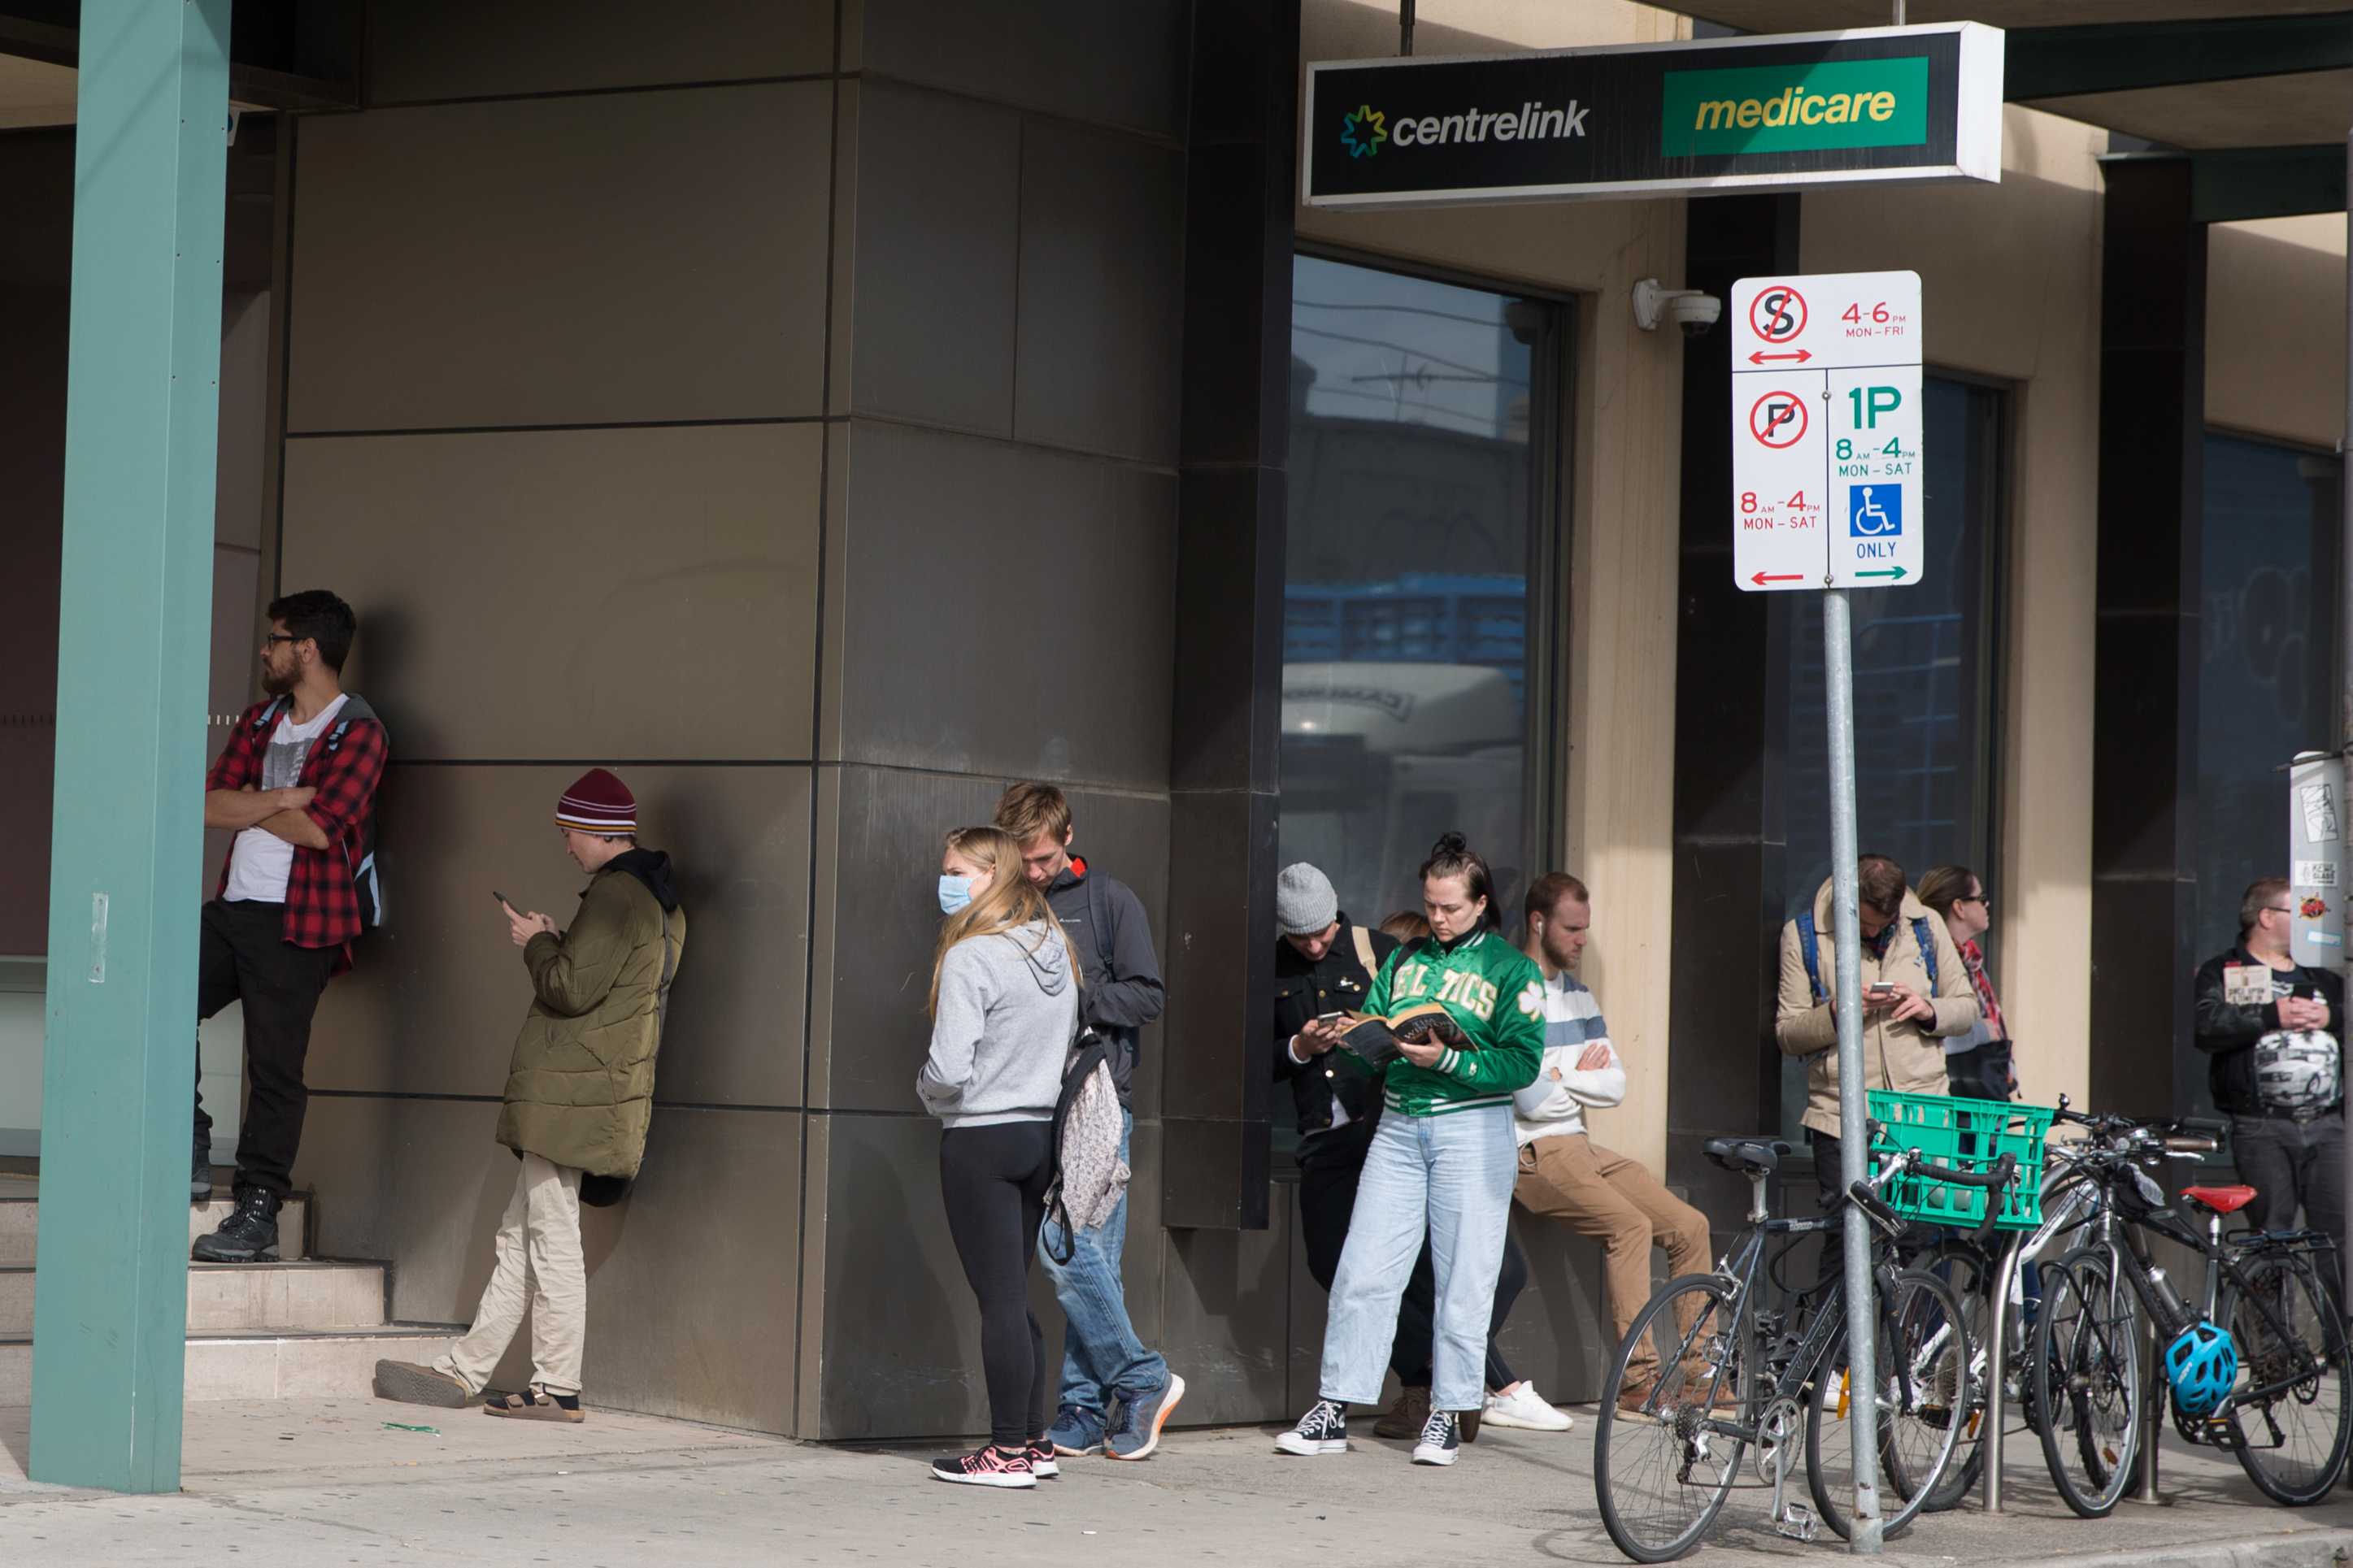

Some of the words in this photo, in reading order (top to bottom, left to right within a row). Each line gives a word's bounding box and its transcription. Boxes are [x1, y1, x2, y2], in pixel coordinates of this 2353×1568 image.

[1393, 99, 1590, 147] centrelink
[1694, 85, 1896, 132] medicare
[1849, 386, 1902, 429] 1P
[1856, 542, 1897, 558] ONLY
[1391, 963, 1498, 1022] ELTICS
